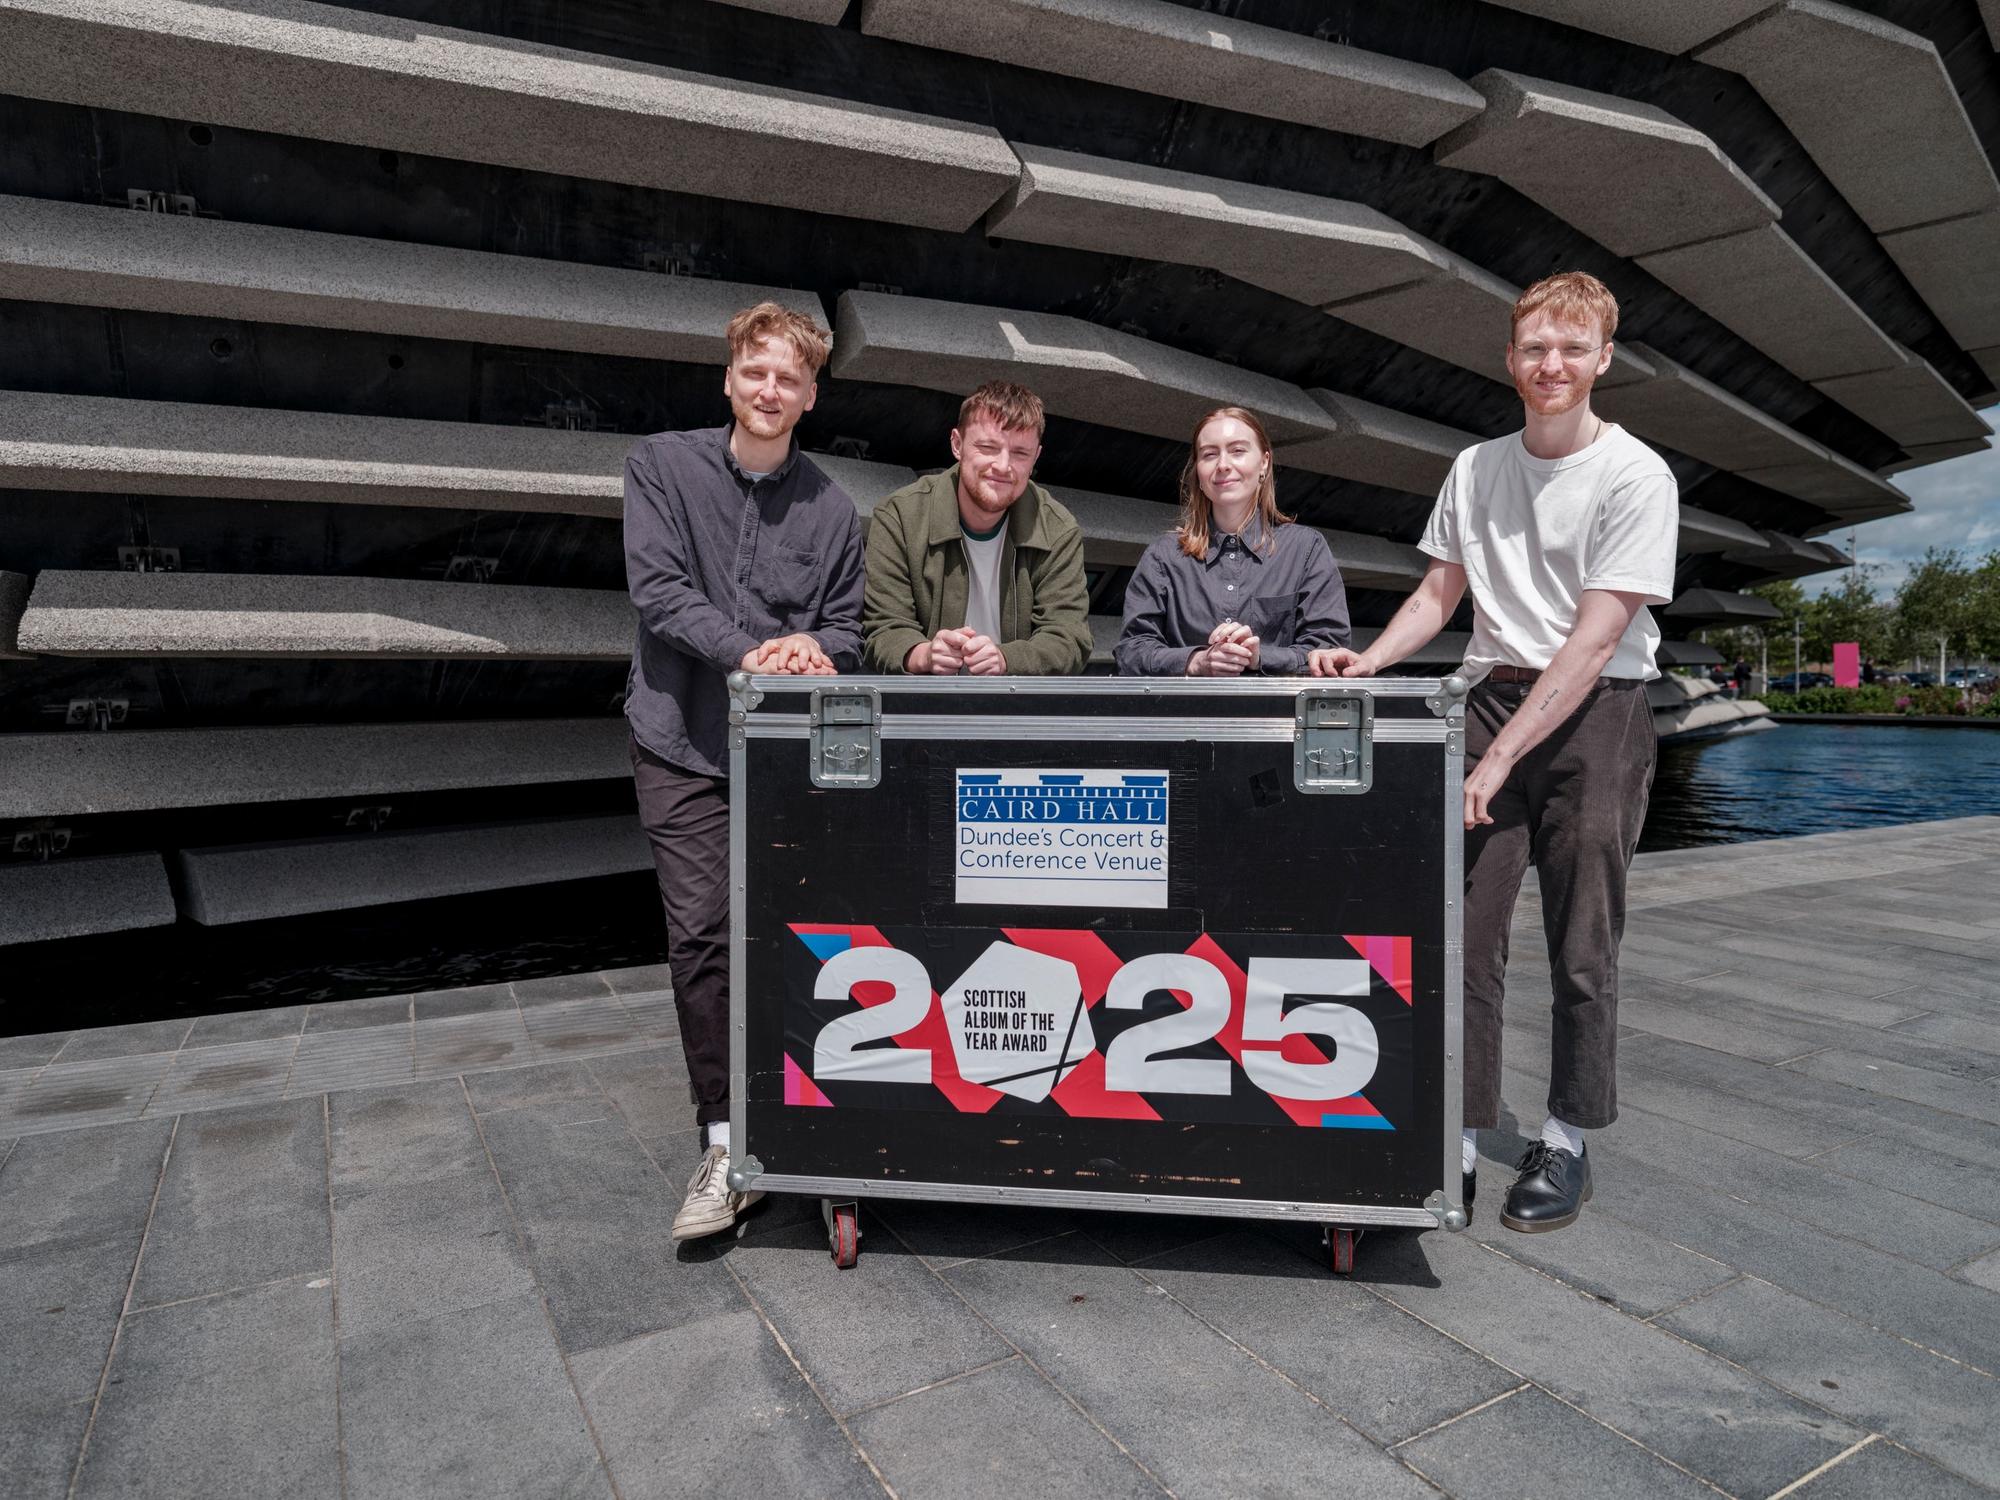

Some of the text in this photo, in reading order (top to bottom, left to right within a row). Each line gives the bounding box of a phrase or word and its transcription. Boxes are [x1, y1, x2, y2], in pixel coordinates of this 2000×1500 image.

[962, 800, 1162, 821] CAIRD HALL
[960, 827, 1165, 848] Dundee's Concert &
[959, 849, 1162, 871] Conference Venue
[963, 989, 1026, 1009] SCOTTISH
[964, 1011, 1055, 1031] ALBUM OF THE
[964, 1032, 1047, 1052] YEAR AWARD
